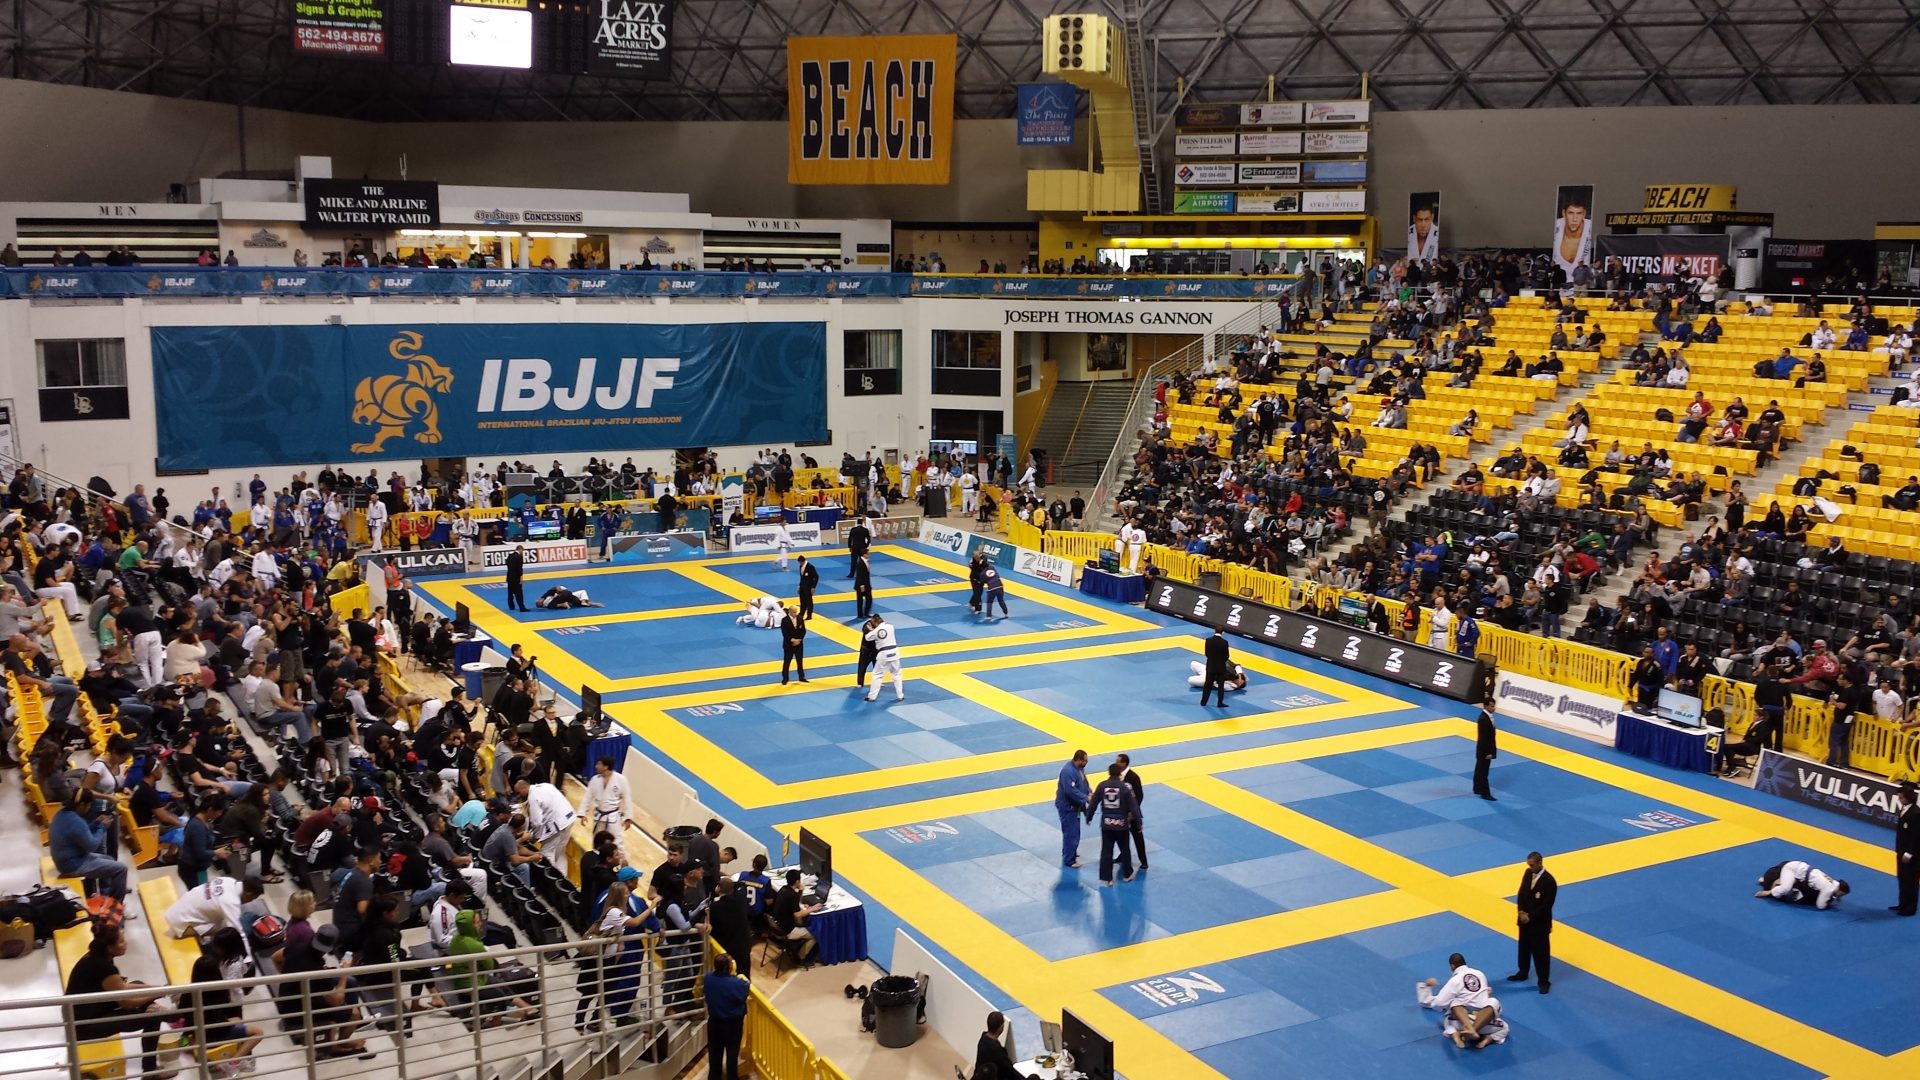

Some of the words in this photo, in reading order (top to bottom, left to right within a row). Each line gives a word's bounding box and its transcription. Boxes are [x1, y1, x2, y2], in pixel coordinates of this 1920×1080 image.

[296, 3, 324, 16] Signs
[327, 5, 335, 15] &
[338, 6, 382, 19] Graphics
[600, 0, 664, 23] LAZY
[298, 28, 382, 43] 562-494-8676
[592, 19, 666, 50] ACRES
[301, 40, 378, 52] MachanSign.com
[618, 40, 650, 50] MARKET
[801, 60, 935, 160] BEACH
[1253, 168, 1297, 176] Enterprise
[362, 186, 385, 196] THE
[320, 197, 354, 208] MIKE
[356, 199, 379, 209] AND
[380, 199, 427, 210] ARLINE
[99, 205, 137, 216] MEN
[318, 212, 369, 222] WALTER
[372, 213, 431, 224] PYRAMID
[1608, 215, 1627, 225] LONG
[1628, 215, 1649, 225] BEACH
[1650, 214, 1673, 224] STATE
[1674, 213, 1713, 224] ATHLETICS
[748, 220, 801, 230] WOMEN
[1767, 244, 1798, 256] FIGHTERS
[46, 278, 79, 287] IBJJF
[165, 278, 196, 287] IBJJF
[277, 278, 307, 287] IBJJF
[384, 278, 413, 287] IBJJF
[486, 279, 512, 288] IBJJF
[582, 280, 607, 288] IBJJF
[671, 281, 696, 289] IBJJF
[757, 281, 780, 289] IBJJF
[838, 281, 861, 289] IBJJF
[922, 281, 944, 289] IBJJF
[1005, 283, 1028, 291] IBJJF
[1090, 283, 1114, 291] IBJJF
[1177, 283, 1202, 291] IBJJF
[1004, 310, 1059, 325] JOSEPH
[1065, 311, 1134, 324] THOMAS
[1140, 312, 1213, 325] GANNON
[477, 357, 681, 412] IBJJF
[477, 419, 544, 429] INTERNATIONAL
[546, 418, 591, 428] BRAZILIAN
[592, 416, 631, 426] JIU-JITSU
[632, 416, 682, 425] FEDERATION
[538, 545, 586, 562] MARKET
[1706, 736, 1718, 751] 4
[1800, 788, 1821, 801] THE
[746, 885, 757, 907] 9
